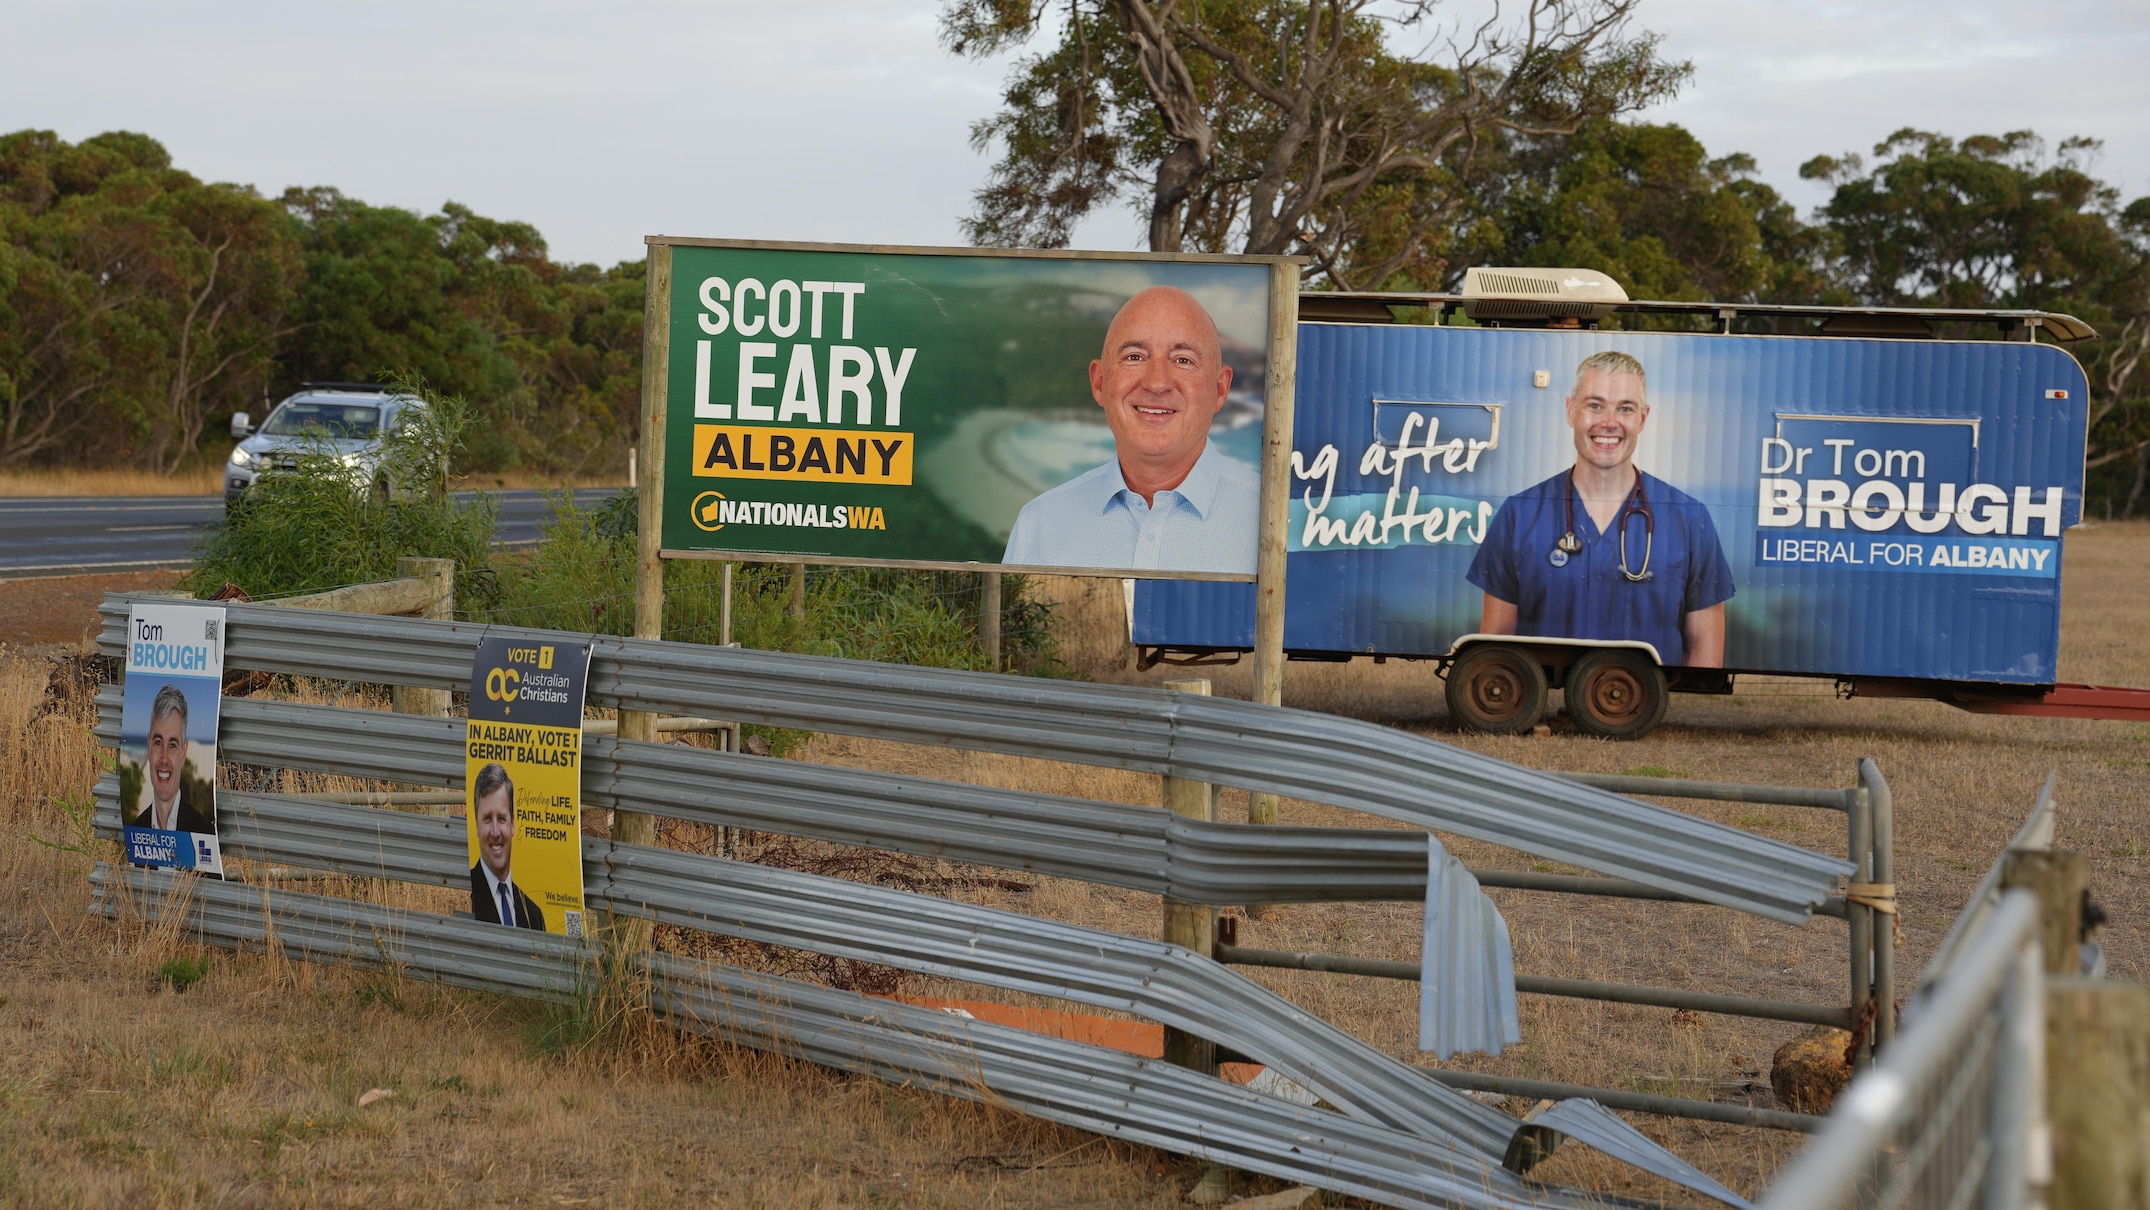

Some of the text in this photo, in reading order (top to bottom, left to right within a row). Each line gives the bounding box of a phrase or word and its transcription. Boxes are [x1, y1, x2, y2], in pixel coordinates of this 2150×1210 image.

[697, 276, 866, 340] SCOTT
[694, 340, 918, 426] LEARY
[703, 432, 904, 476] ALBANY
[1360, 411, 1492, 499] after
[1760, 437, 1926, 478] Dr Tom
[1302, 486, 1493, 548] matters
[1757, 478, 2063, 536] BROUGH
[1761, 538, 2051, 571] LIBERAL FOR ALBANY
[136, 618, 163, 641] Tom
[133, 643, 207, 670] BROUGH
[507, 647, 537, 664] VOTE
[521, 671, 570, 688] Australian
[520, 687, 568, 704] Christians
[469, 724, 578, 748] IN ALBANY, VOTE 1
[469, 742, 577, 768] GERRIT BALLAST
[551, 795, 573, 811] LIFE,
[516, 809, 576, 826] FAITH, FAMILY
[131, 832, 177, 848] LIBERAL FOR
[525, 826, 567, 842] FREEDOM
[134, 845, 175, 862] ALBANY
